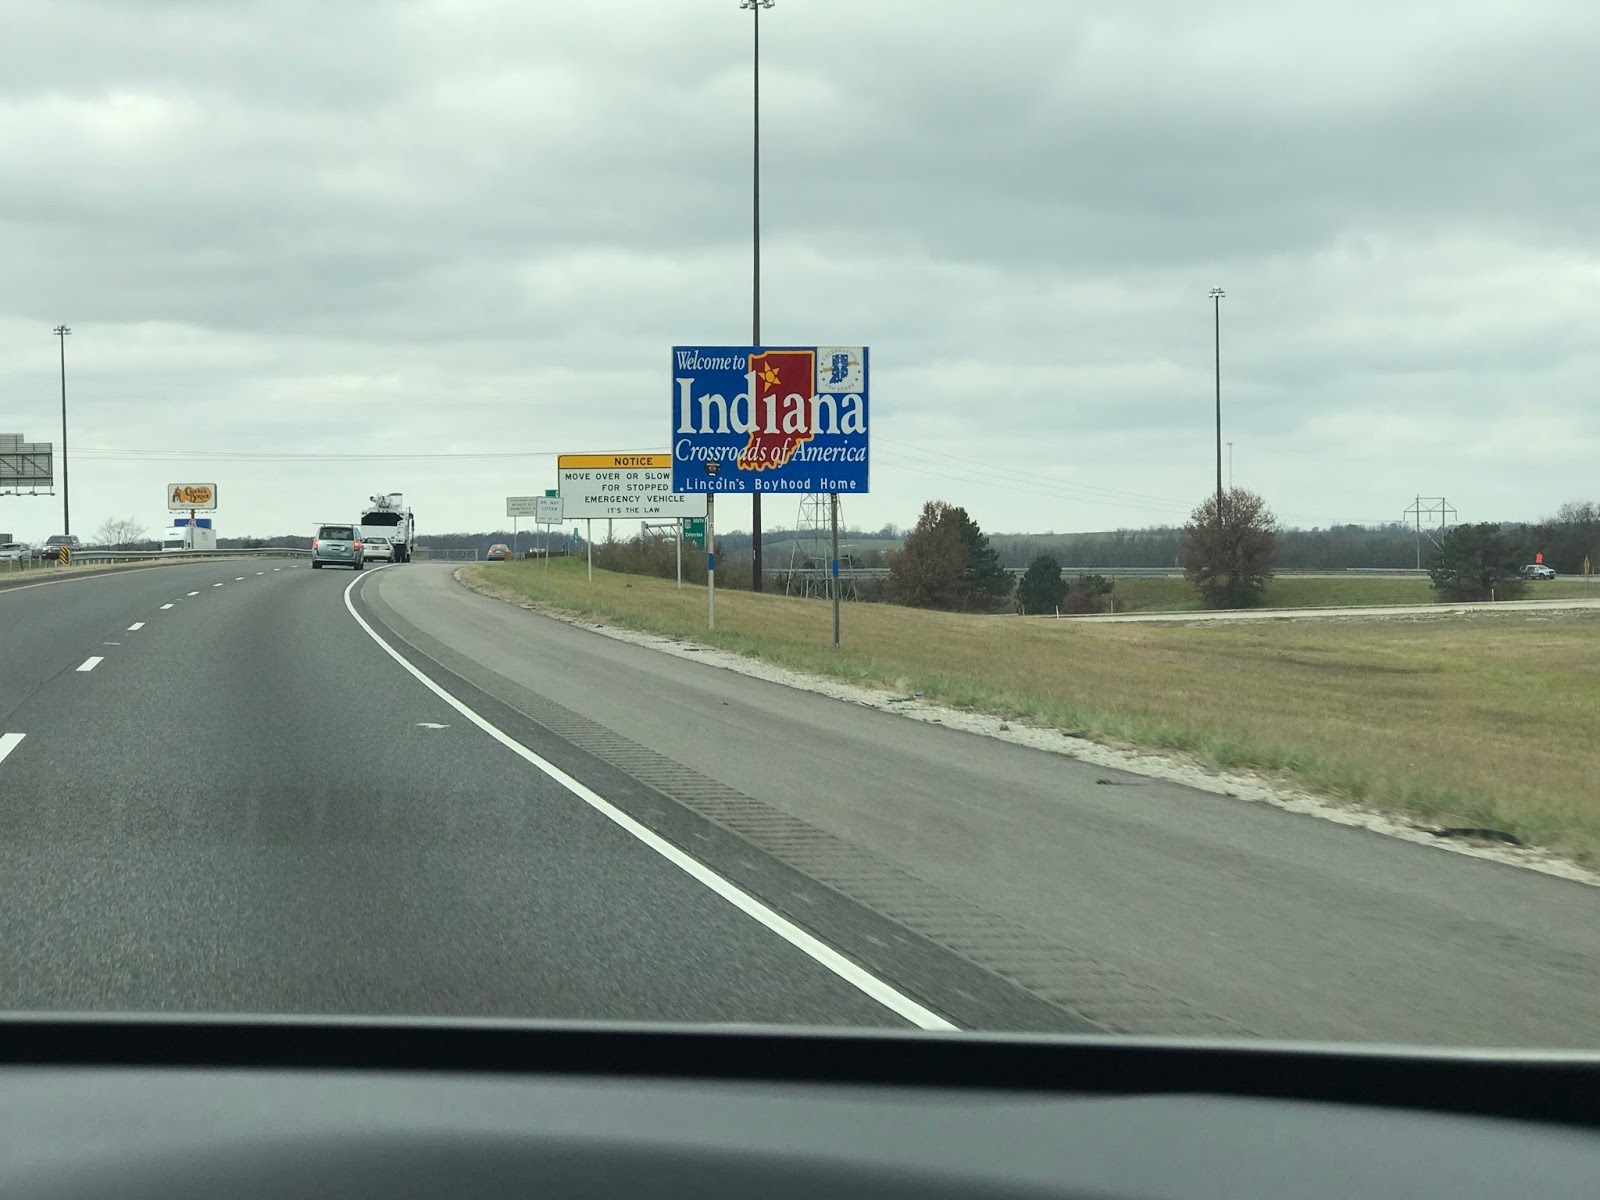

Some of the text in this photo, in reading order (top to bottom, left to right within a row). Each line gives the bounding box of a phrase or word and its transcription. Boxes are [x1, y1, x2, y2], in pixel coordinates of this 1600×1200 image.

[676, 350, 746, 371] Welcome to
[675, 370, 867, 434] Indiana
[675, 437, 866, 469] Crossroads of America
[614, 457, 653, 466] NOTICE
[595, 472, 620, 480] OVER
[645, 472, 670, 480] SLOW
[601, 484, 620, 492] FOR
[686, 478, 857, 492] Lincoln's Boyhood Home
[647, 495, 685, 503] VEHICLE
